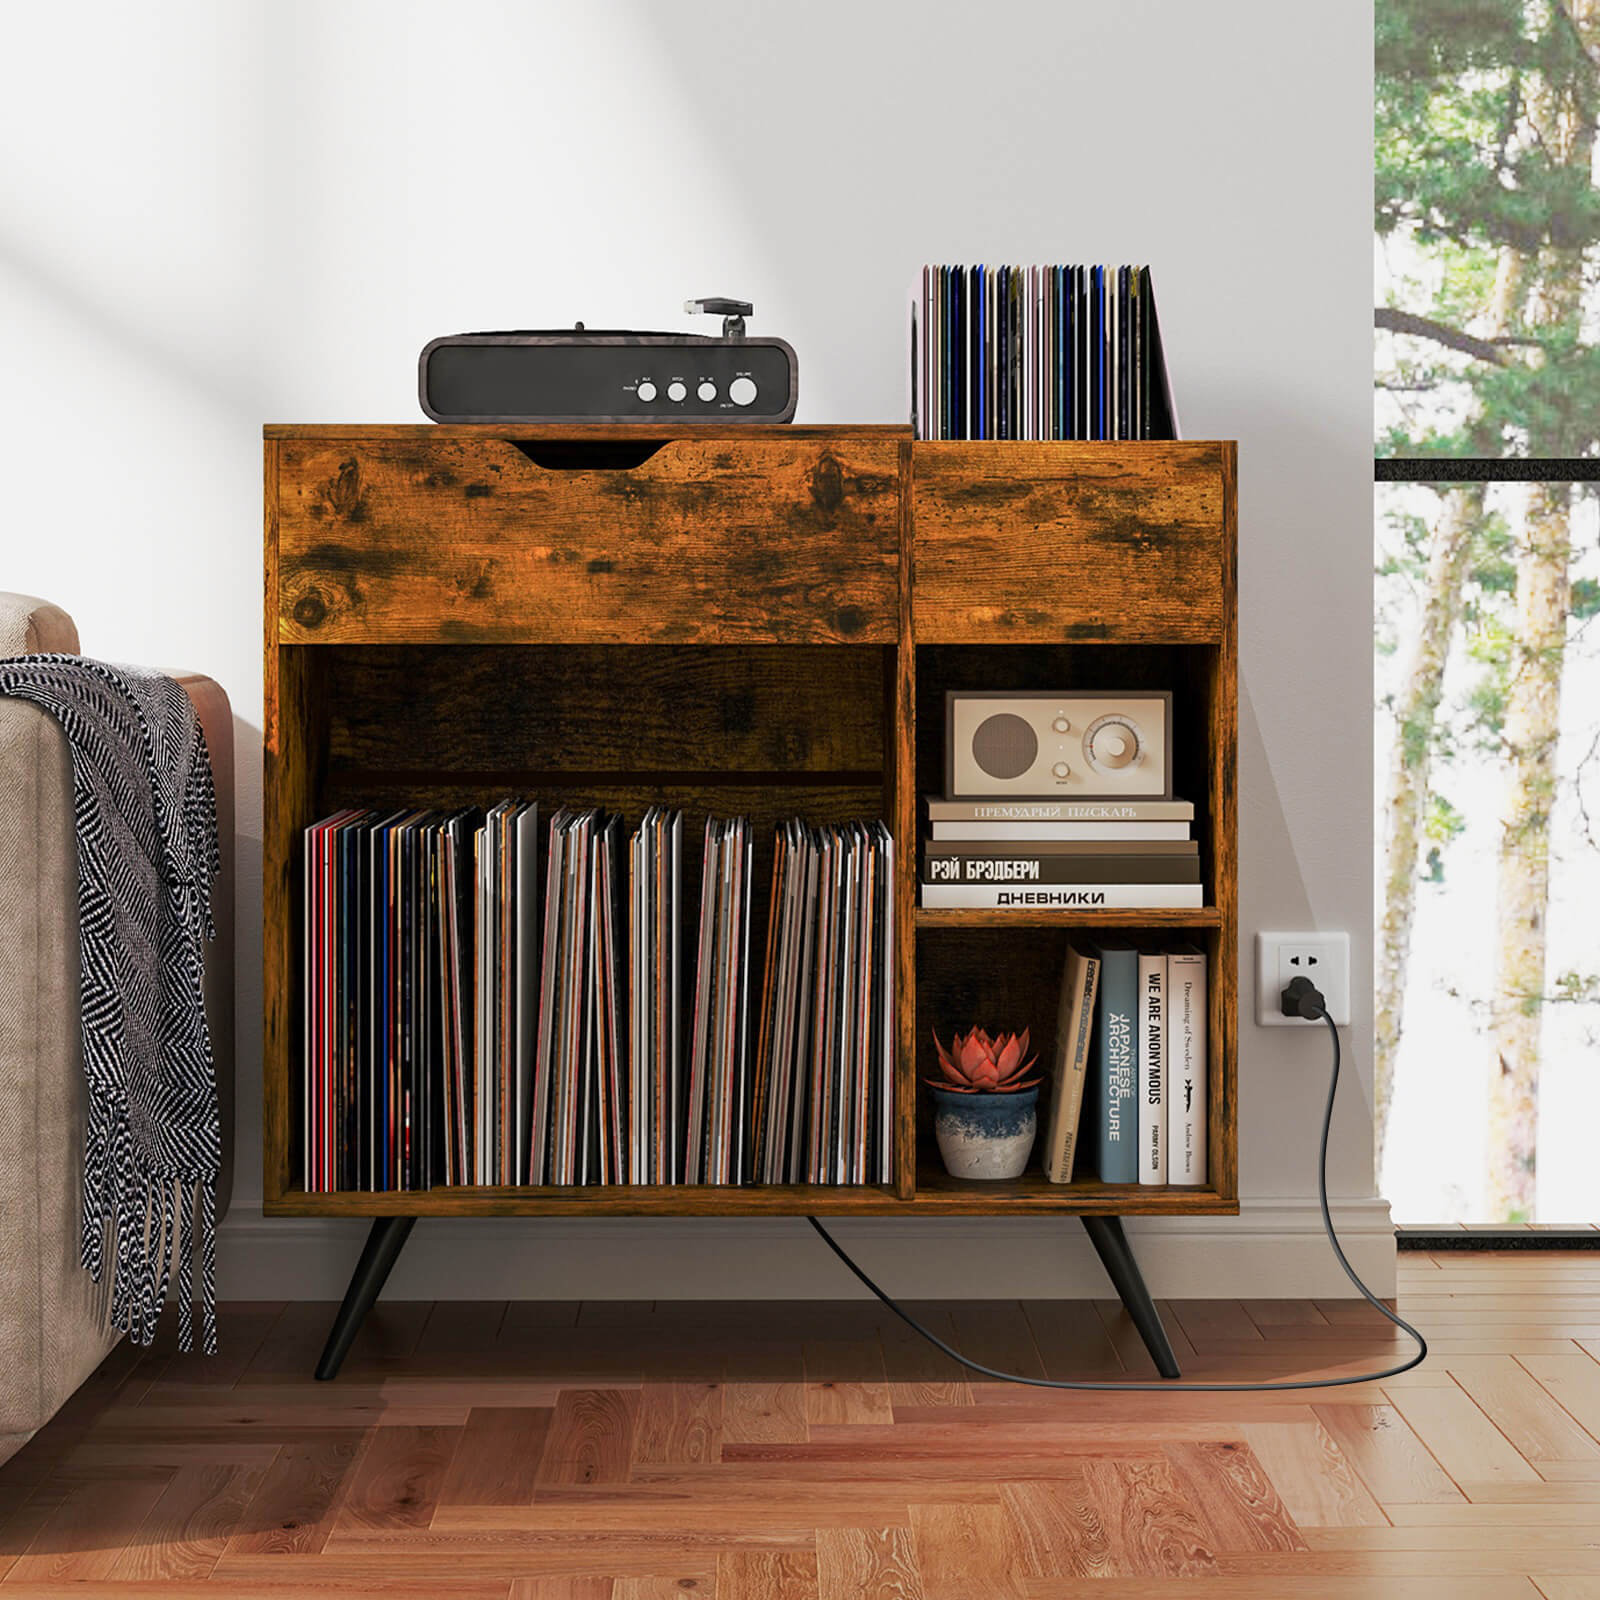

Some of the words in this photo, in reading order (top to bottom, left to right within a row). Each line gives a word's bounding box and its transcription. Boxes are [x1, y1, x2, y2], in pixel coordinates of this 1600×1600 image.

[931, 857, 960, 880] РЭЙ
[966, 861, 1040, 880] БРЭДБЕРИ
[997, 892, 1105, 905] ДНЕВНИКИ
[1148, 973, 1161, 993] WE
[1148, 996, 1161, 1021] ARE
[1183, 981, 1192, 1025] Dreaming
[1184, 1026, 1193, 1036] of
[1119, 1013, 1130, 1099] JAPANESE
[1148, 1024, 1161, 1105] ANONYMOUS
[1184, 1036, 1193, 1071] Sweden
[1108, 1012, 1120, 1142] ARCHITECTURE
